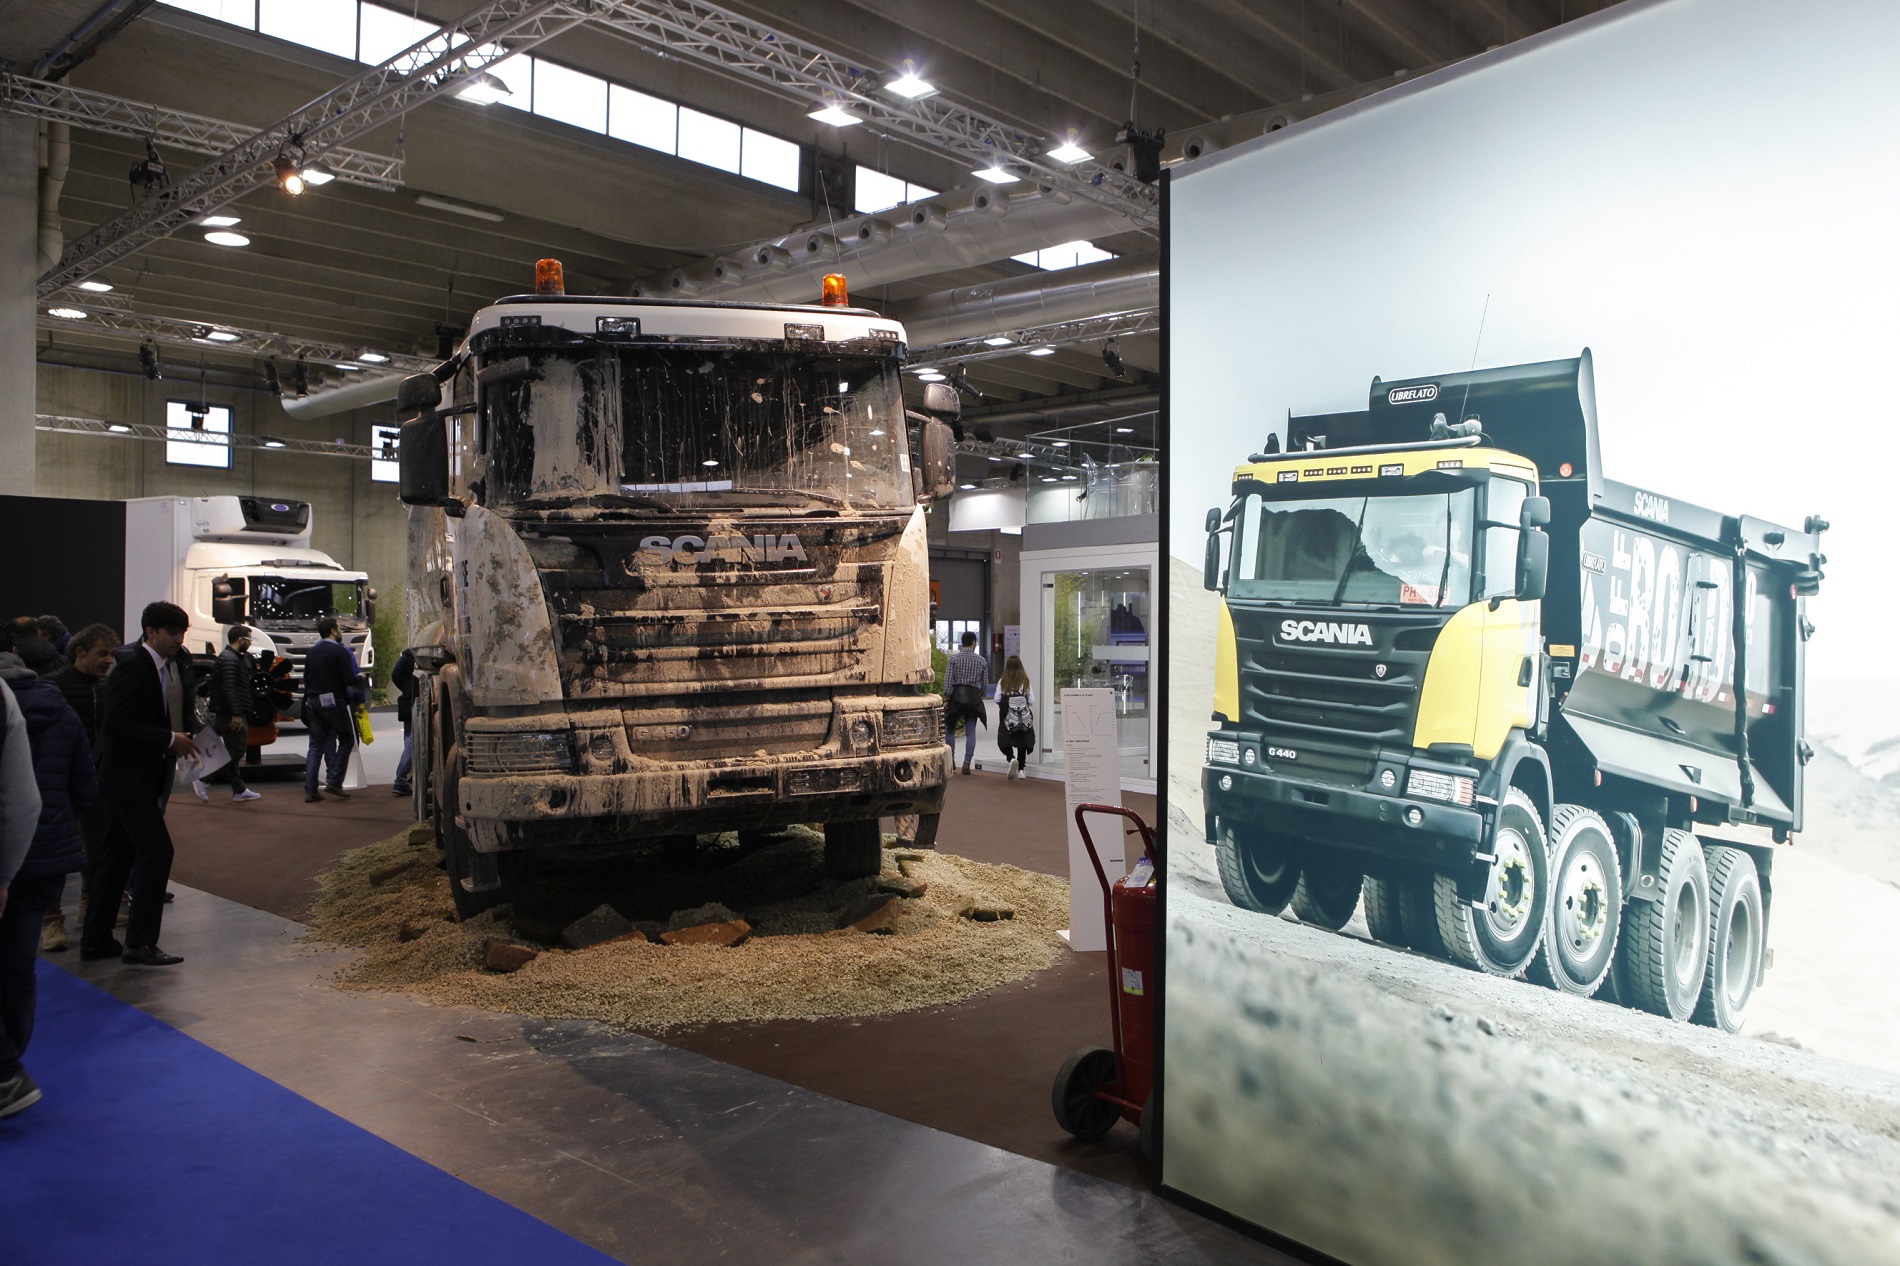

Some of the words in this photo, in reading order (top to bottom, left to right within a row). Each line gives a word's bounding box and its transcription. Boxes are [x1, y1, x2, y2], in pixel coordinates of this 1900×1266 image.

[1391, 387, 1435, 401] LIBRELATO
[1633, 491, 1669, 524] SCANIA
[638, 534, 808, 565] SCANIA
[1280, 620, 1373, 645] SCANIA
